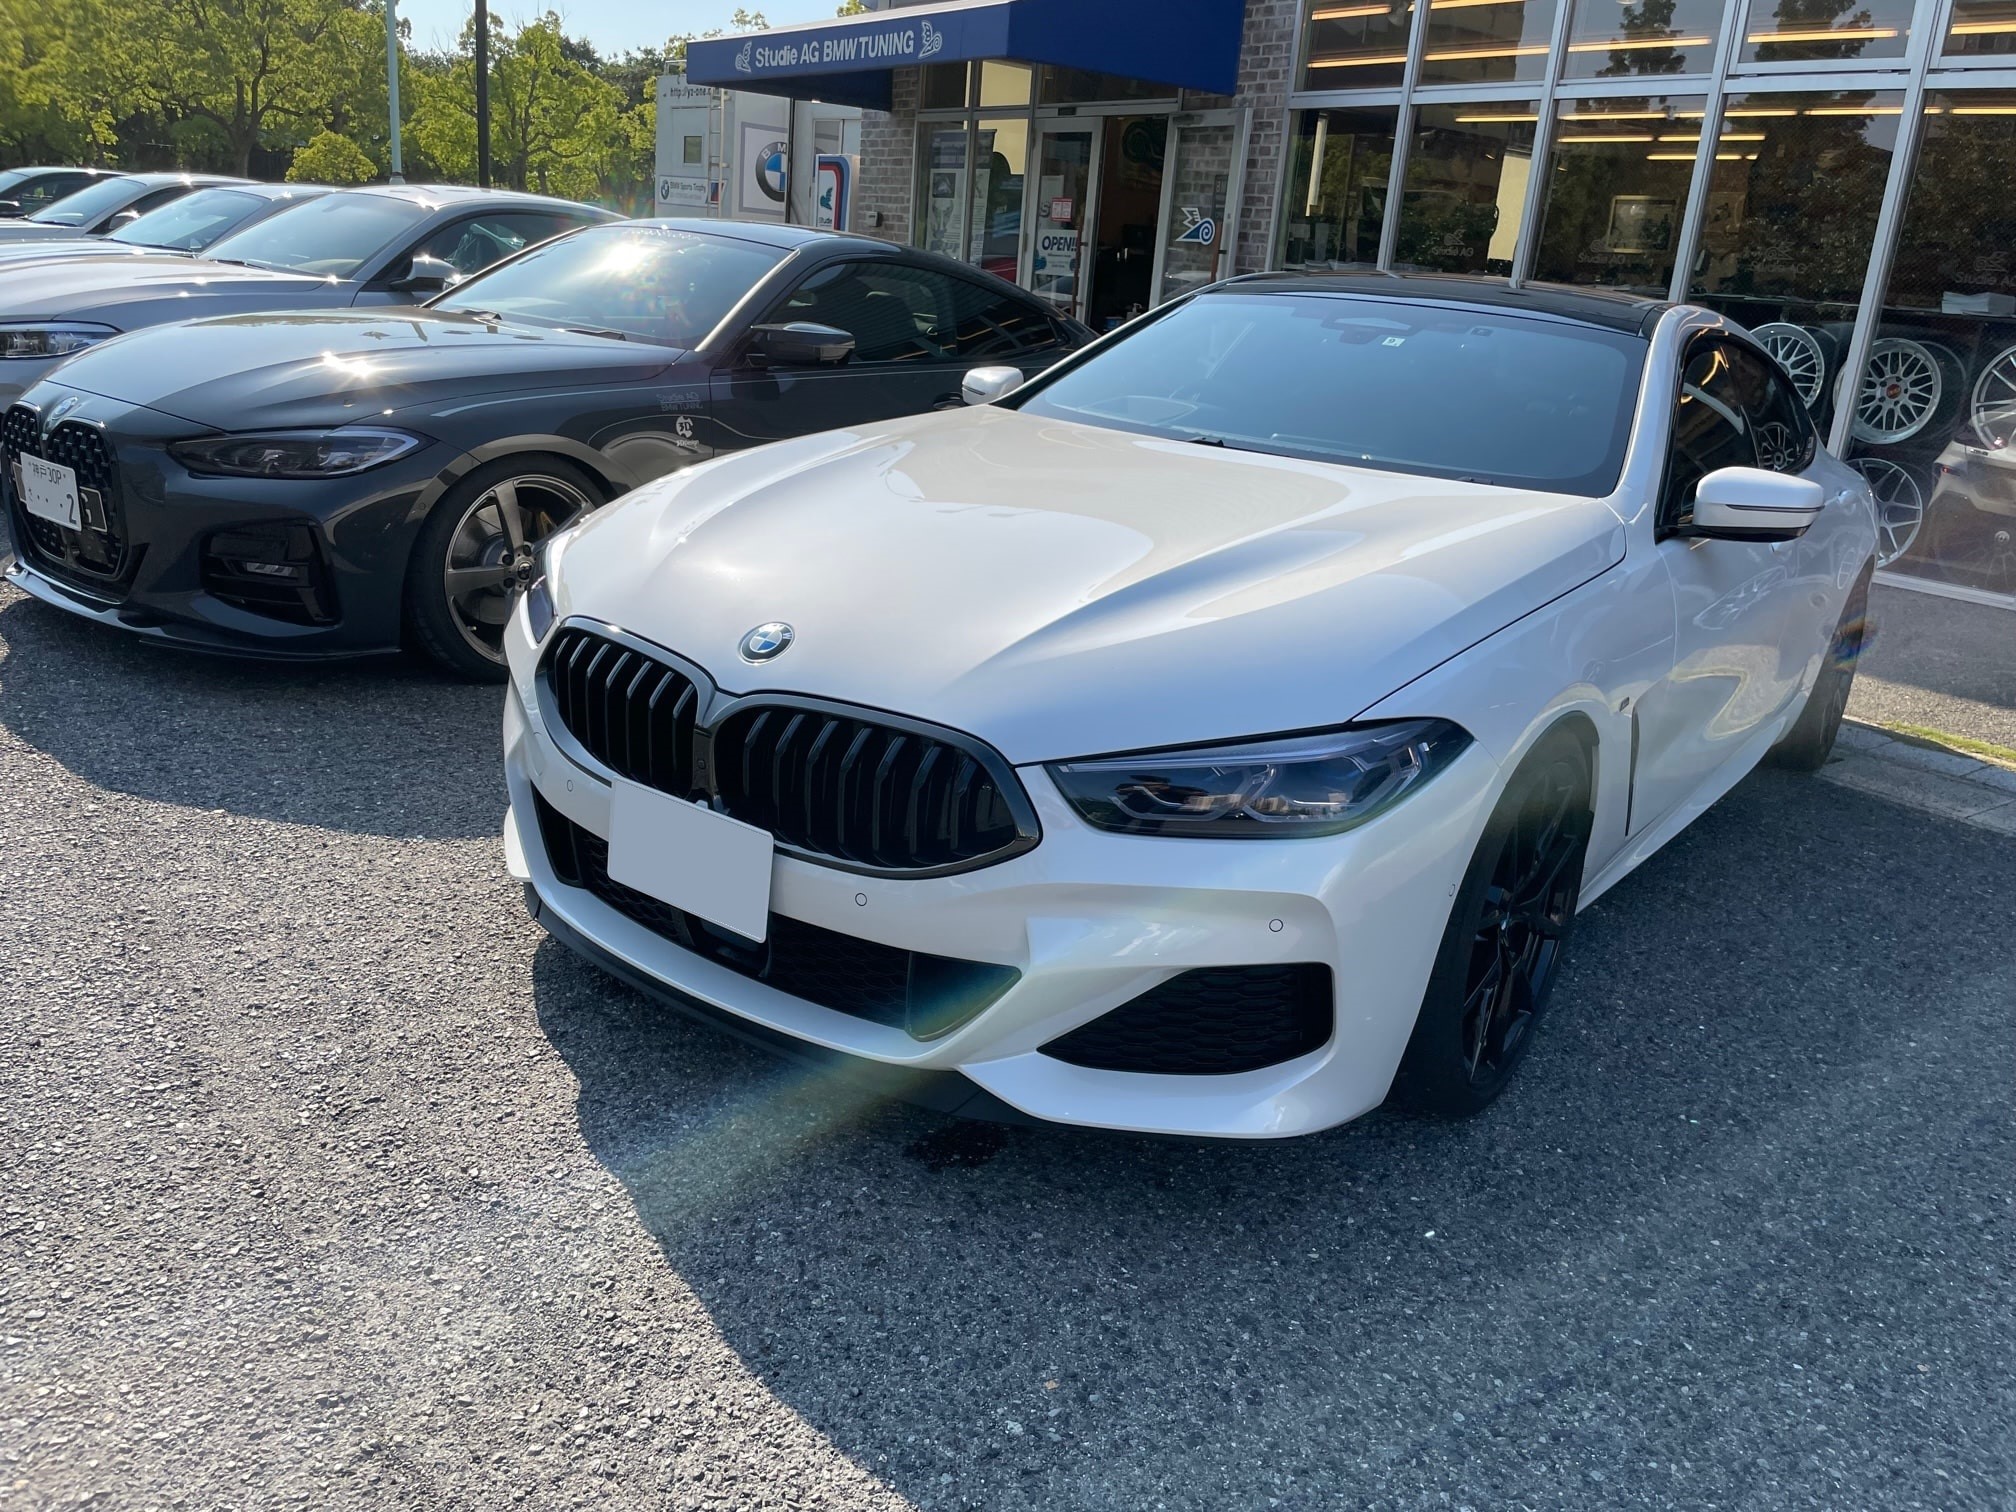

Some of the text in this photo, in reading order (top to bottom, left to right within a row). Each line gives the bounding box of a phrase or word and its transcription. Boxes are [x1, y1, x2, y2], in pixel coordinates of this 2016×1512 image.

[755, 30, 914, 68] Studie AG BMW TUNING
[1041, 235, 1077, 252] OPEN!!
